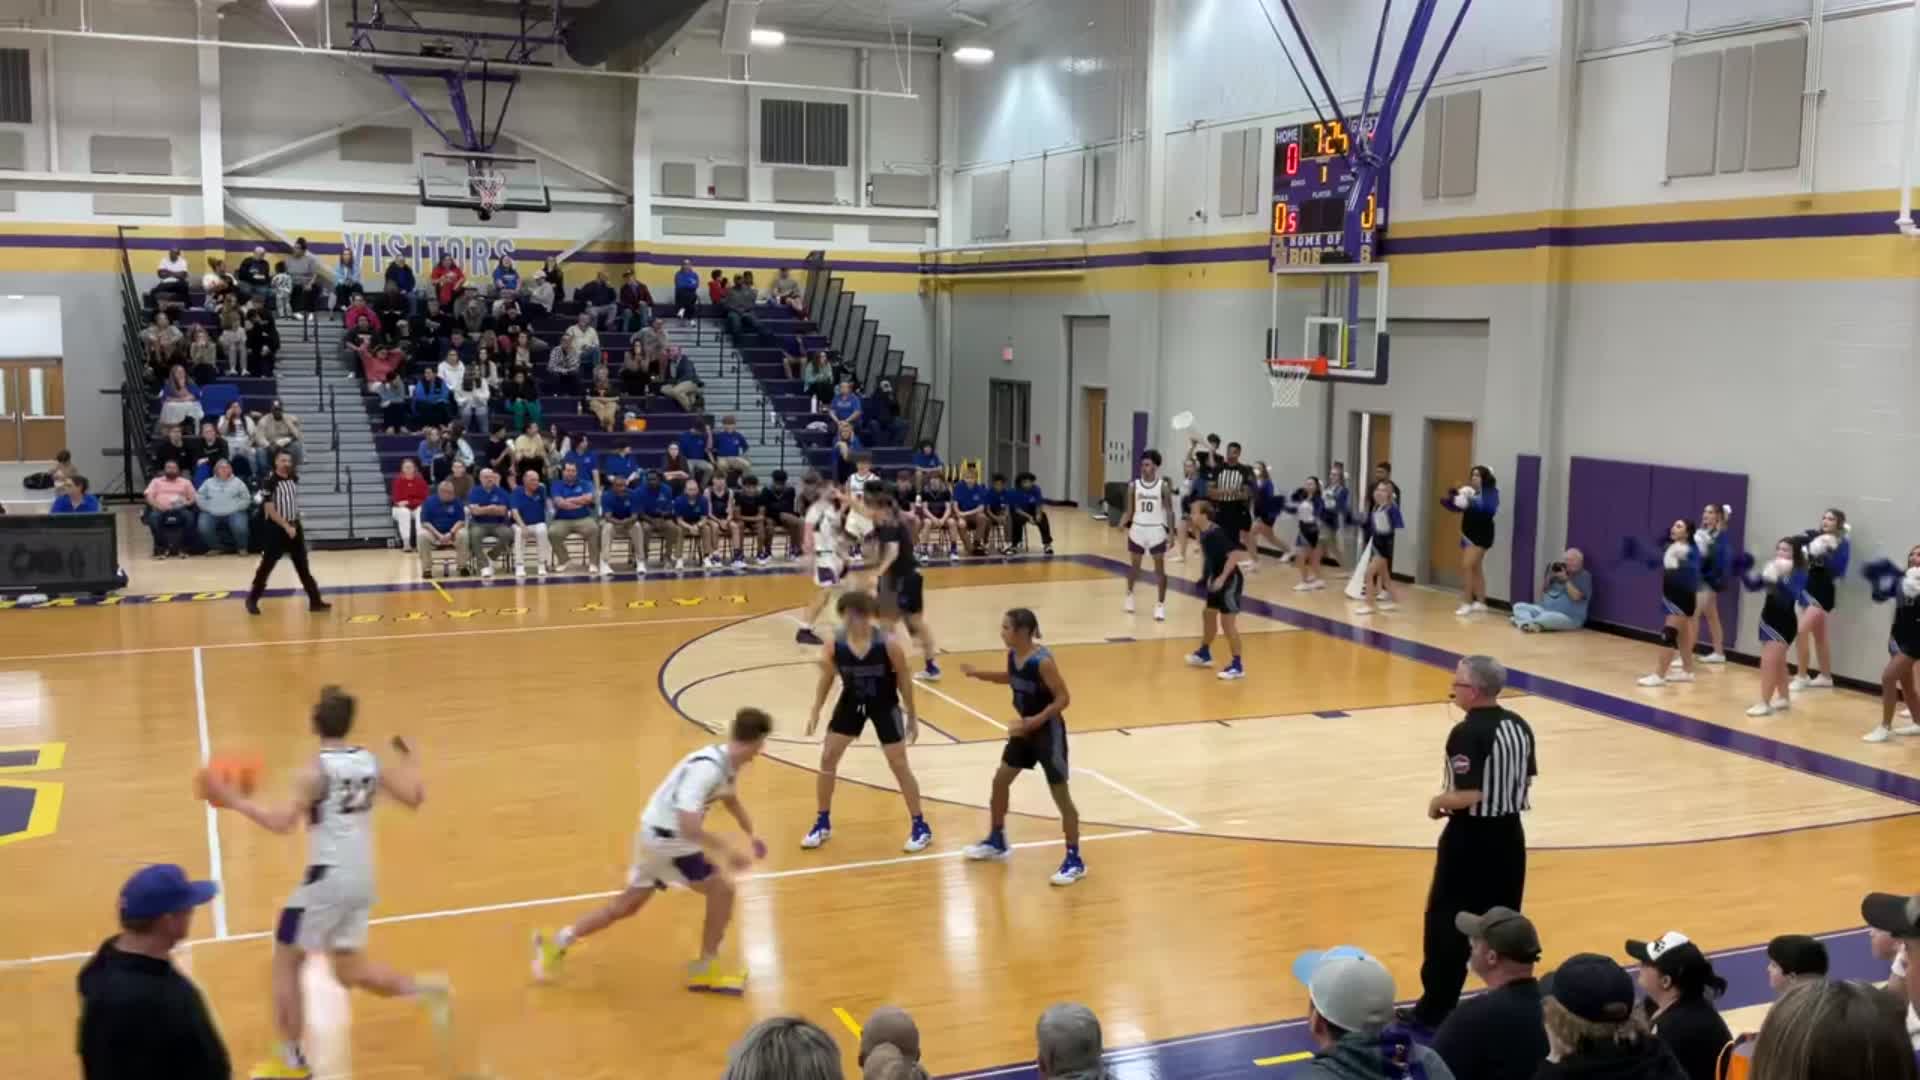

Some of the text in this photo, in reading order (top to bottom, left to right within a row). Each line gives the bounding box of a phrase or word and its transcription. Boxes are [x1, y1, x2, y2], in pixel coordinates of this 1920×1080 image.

[1276, 129, 1298, 145] HOME
[1286, 143, 1298, 175] 0
[1322, 166, 1328, 183] 1
[1289, 232, 1341, 247] HOME OF
[1141, 501, 1154, 513] 10
